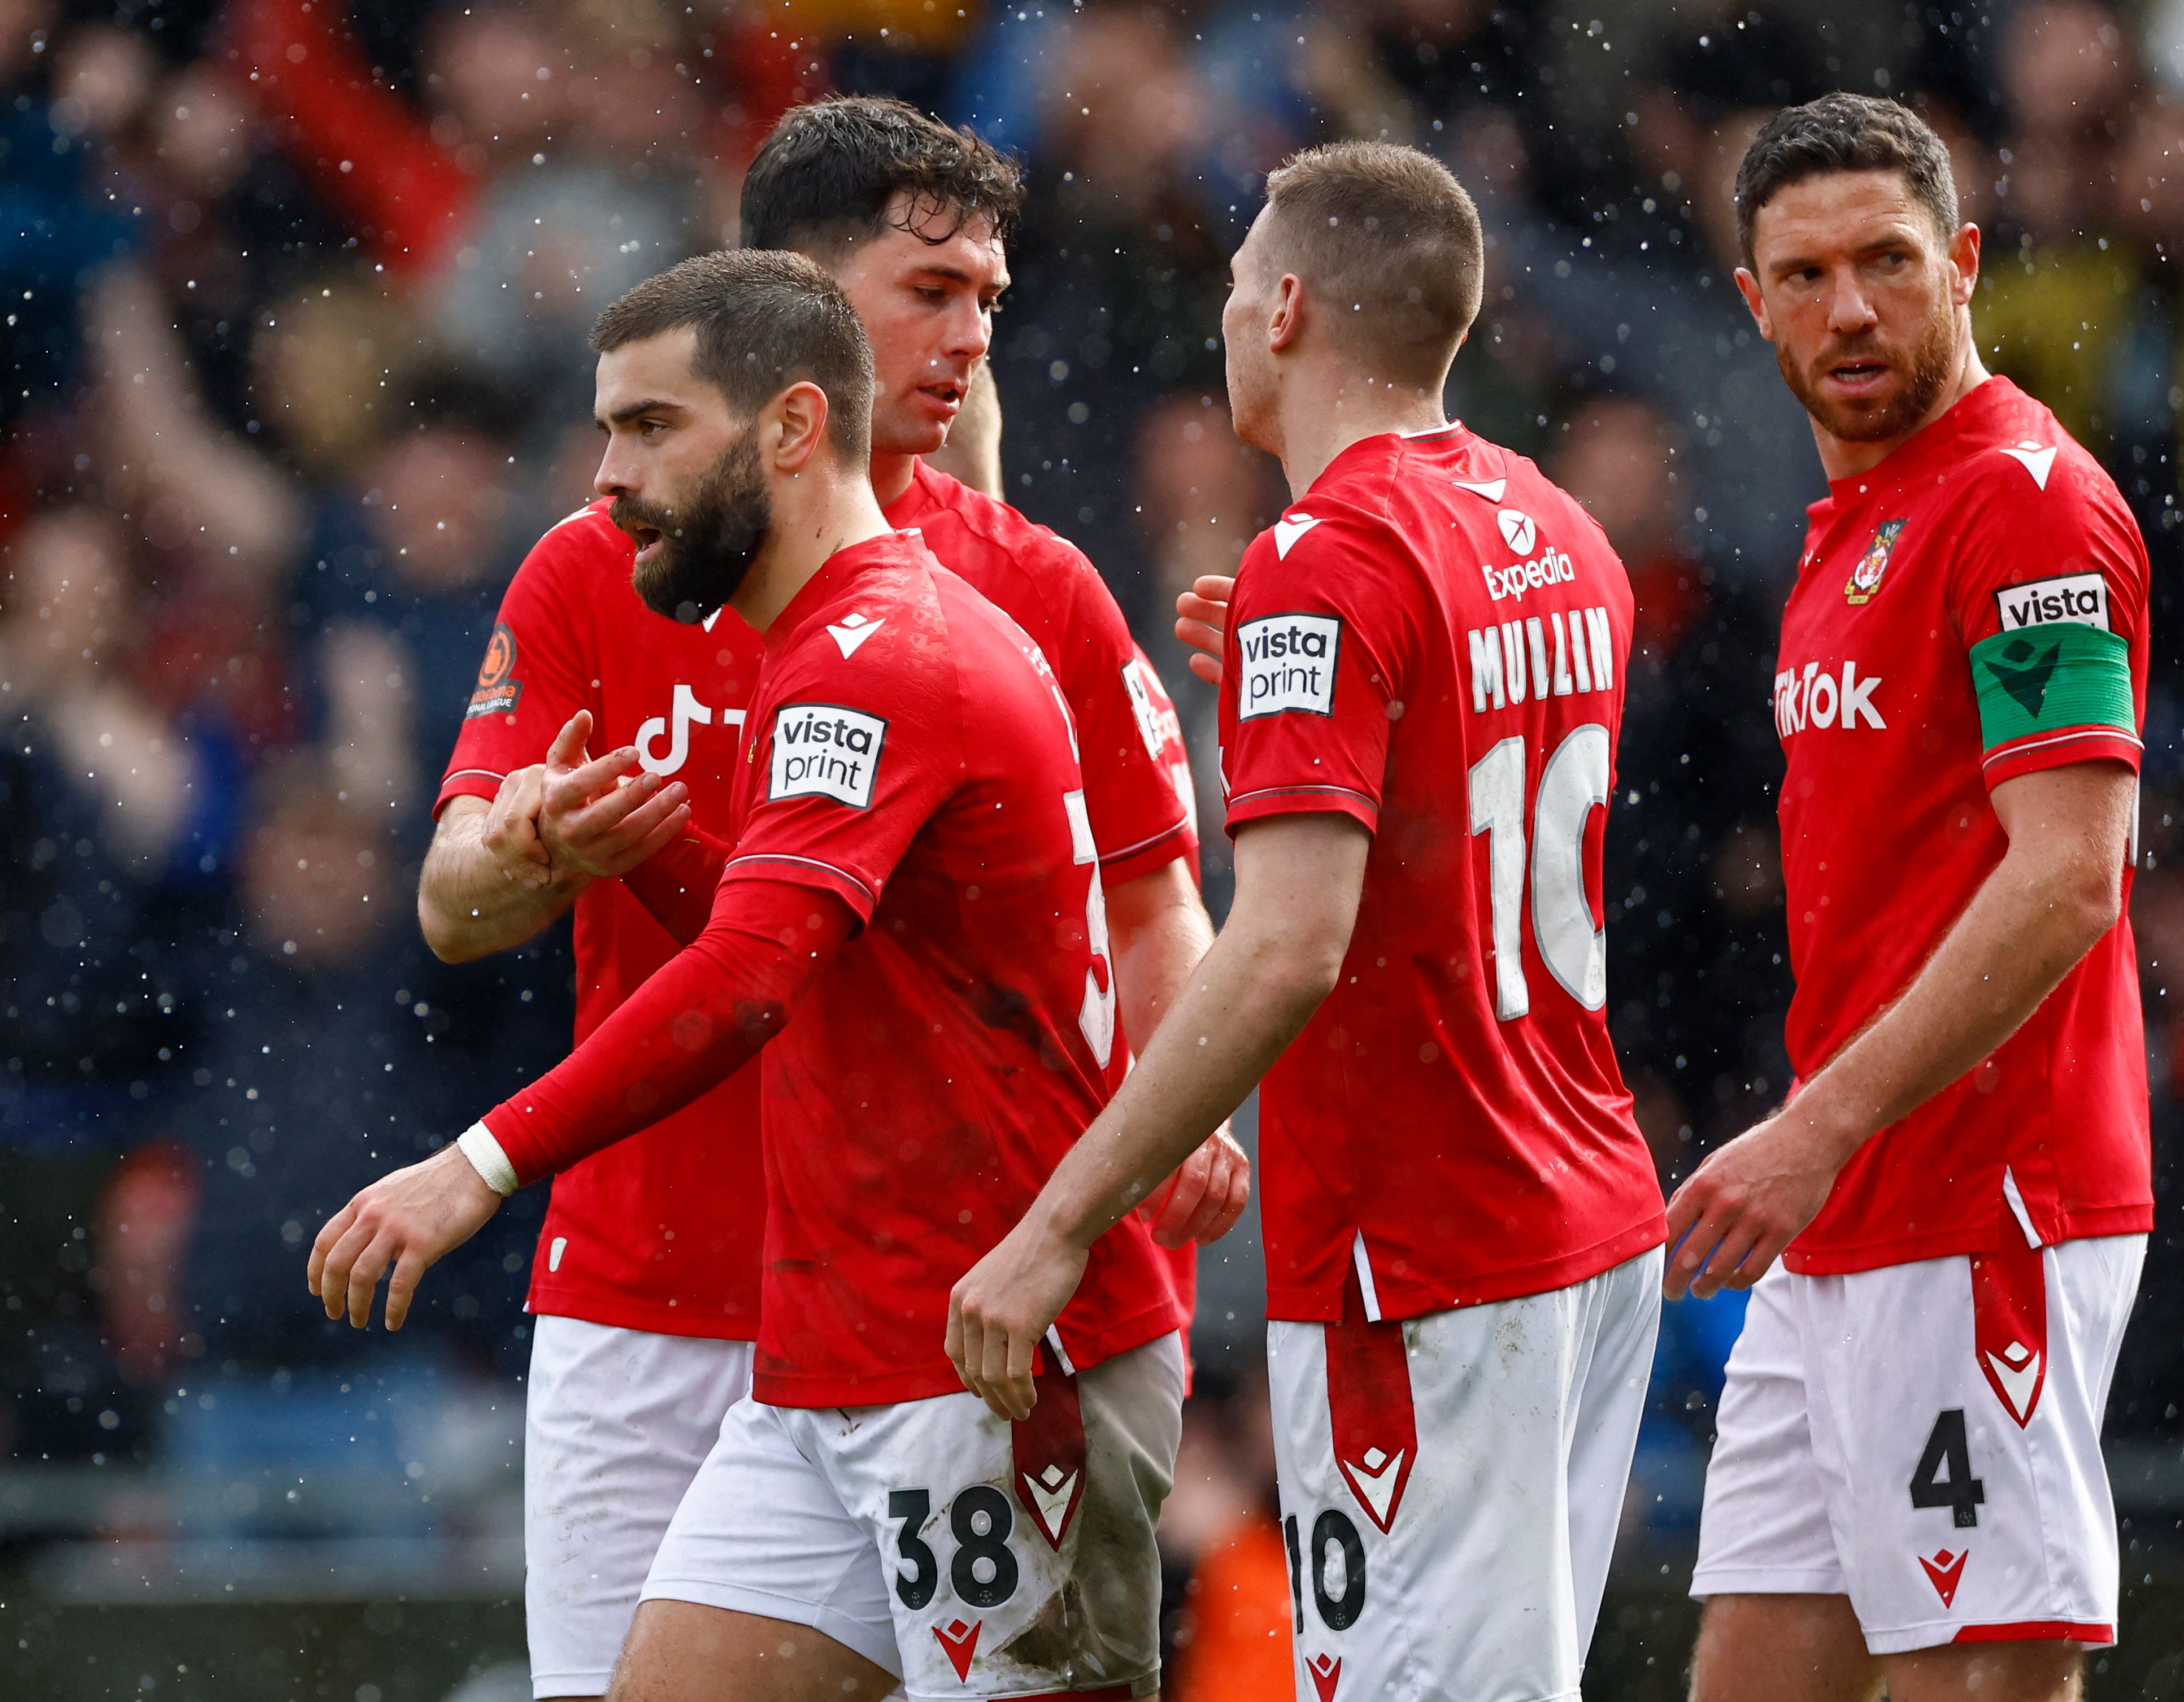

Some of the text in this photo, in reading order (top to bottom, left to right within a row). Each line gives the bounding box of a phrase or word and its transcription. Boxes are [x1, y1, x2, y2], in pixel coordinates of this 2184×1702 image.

[1481, 546, 1575, 602] Expedia
[2008, 589, 2099, 626] vista
[1246, 626, 1327, 663] vista
[1468, 606, 1613, 713] MULLIN
[1250, 662, 1321, 709] print
[1774, 661, 1887, 739] TikTok
[784, 712, 873, 755] vista
[784, 748, 862, 790] print
[1468, 723, 1610, 1022] 10
[1909, 1408, 1985, 1528] 4
[888, 1484, 1019, 1610] 38
